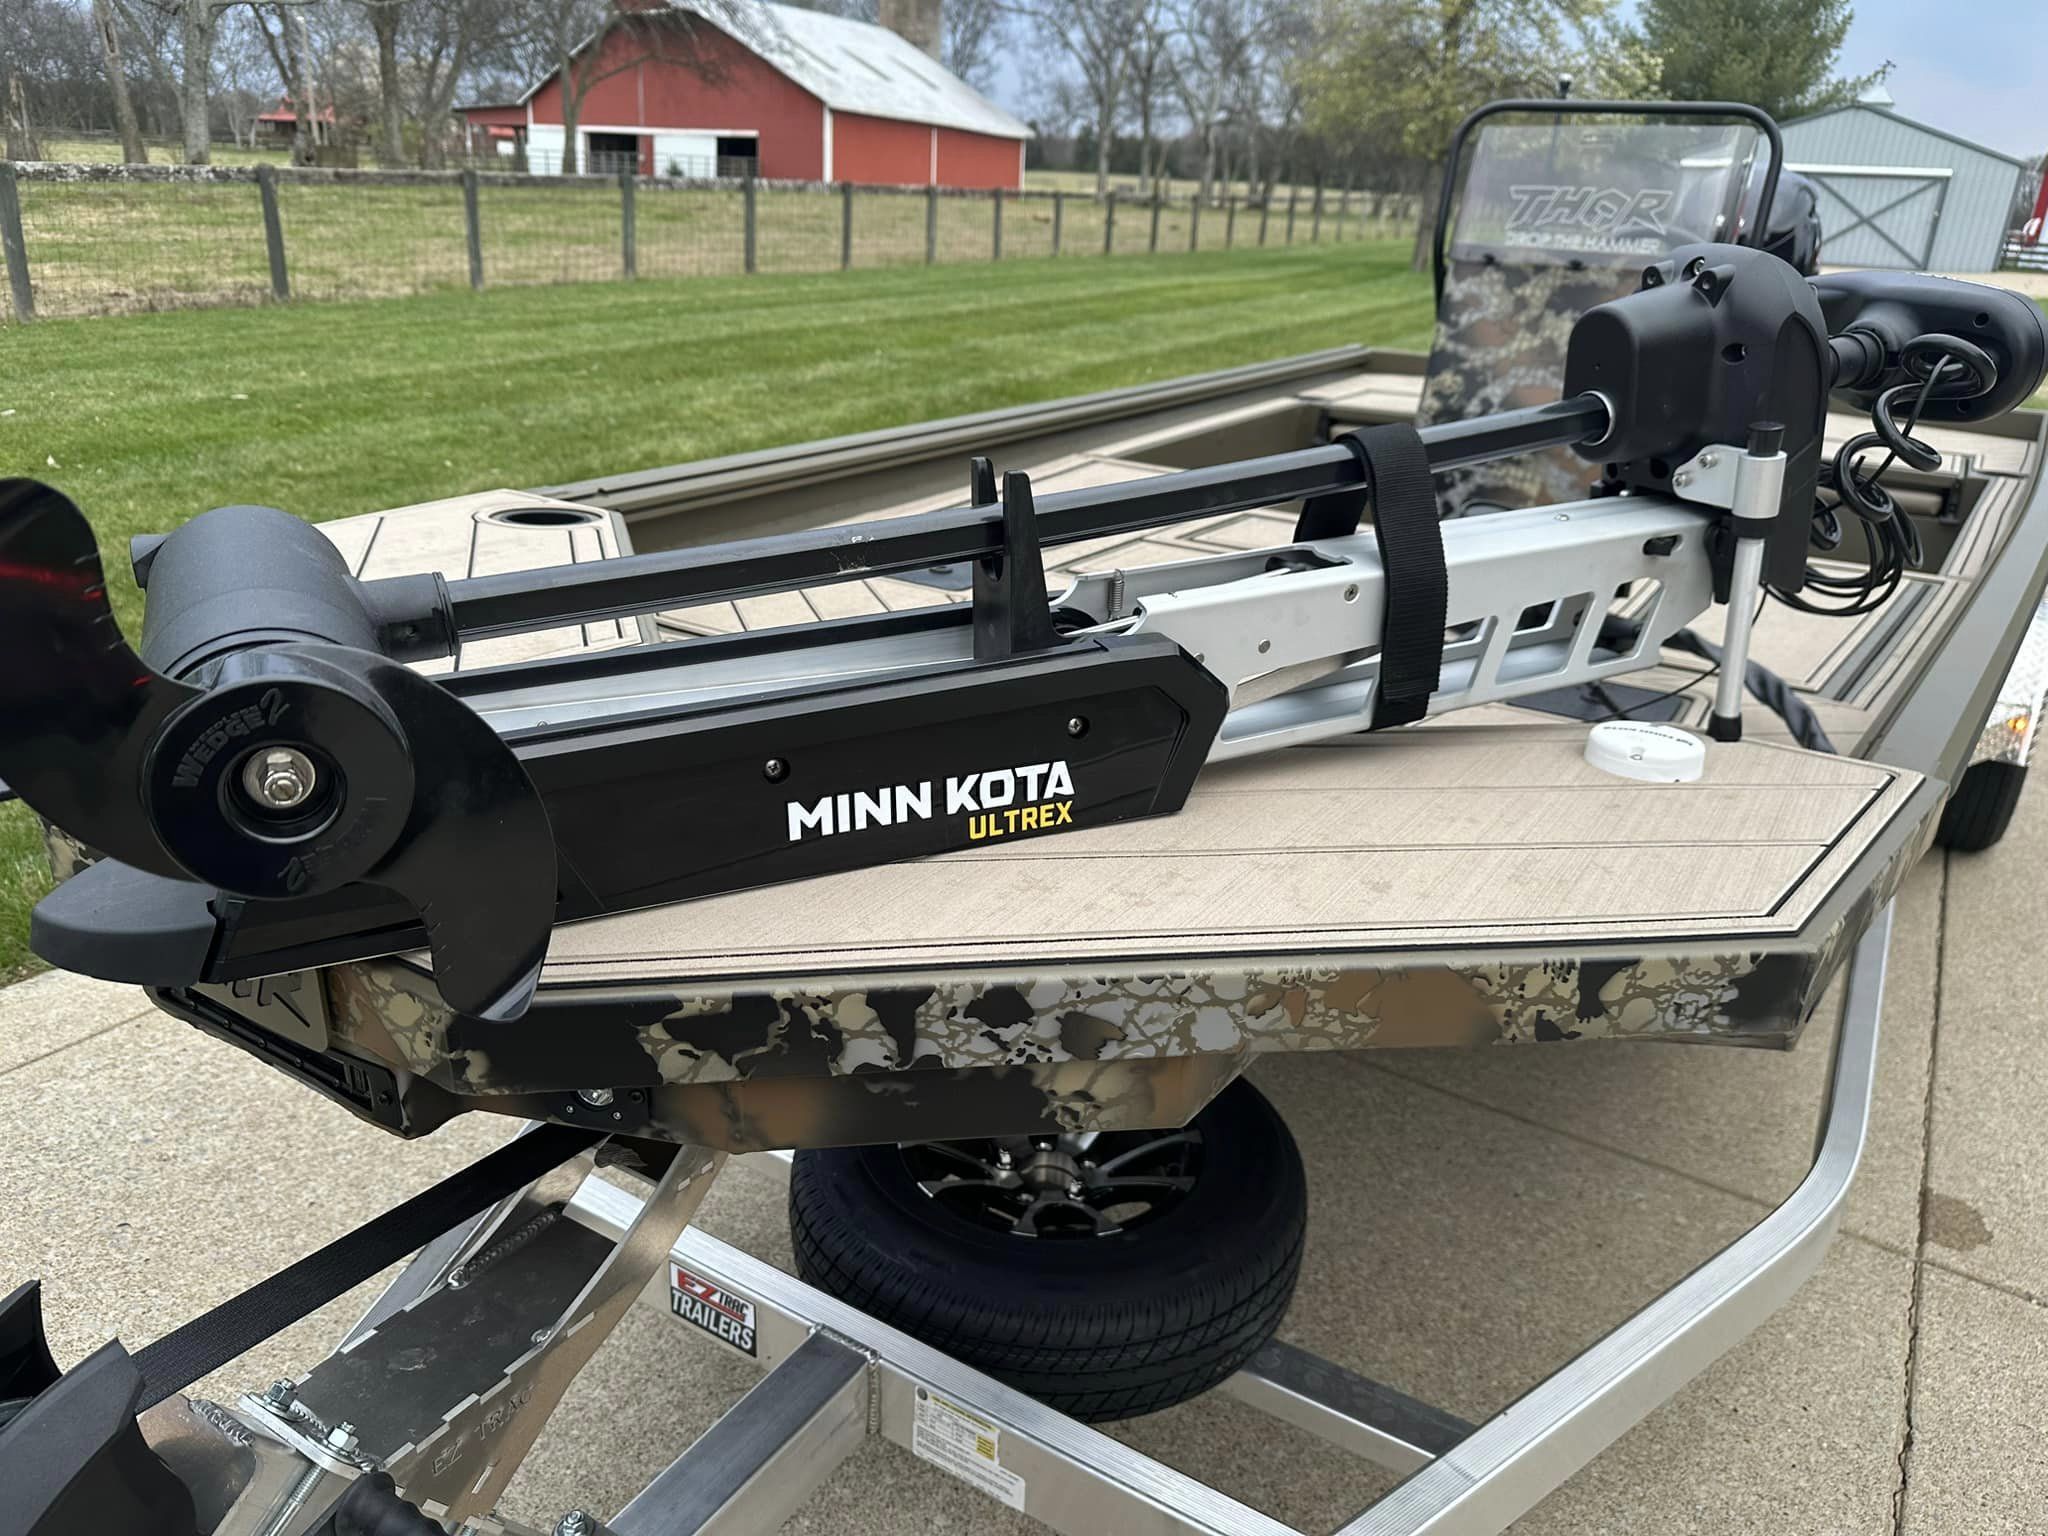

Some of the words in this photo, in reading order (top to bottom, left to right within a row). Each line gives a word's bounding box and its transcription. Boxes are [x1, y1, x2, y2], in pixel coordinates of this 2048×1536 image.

[1504, 184, 1673, 236] THOR
[1504, 231, 1551, 247] DROP
[1554, 233, 1582, 249] THE
[1584, 236, 1661, 255] HAMMER
[787, 780, 932, 841] MINN
[946, 760, 1075, 815] KOTA
[969, 800, 1073, 840] ULTREX
[671, 1289, 754, 1351] TRAILERS
